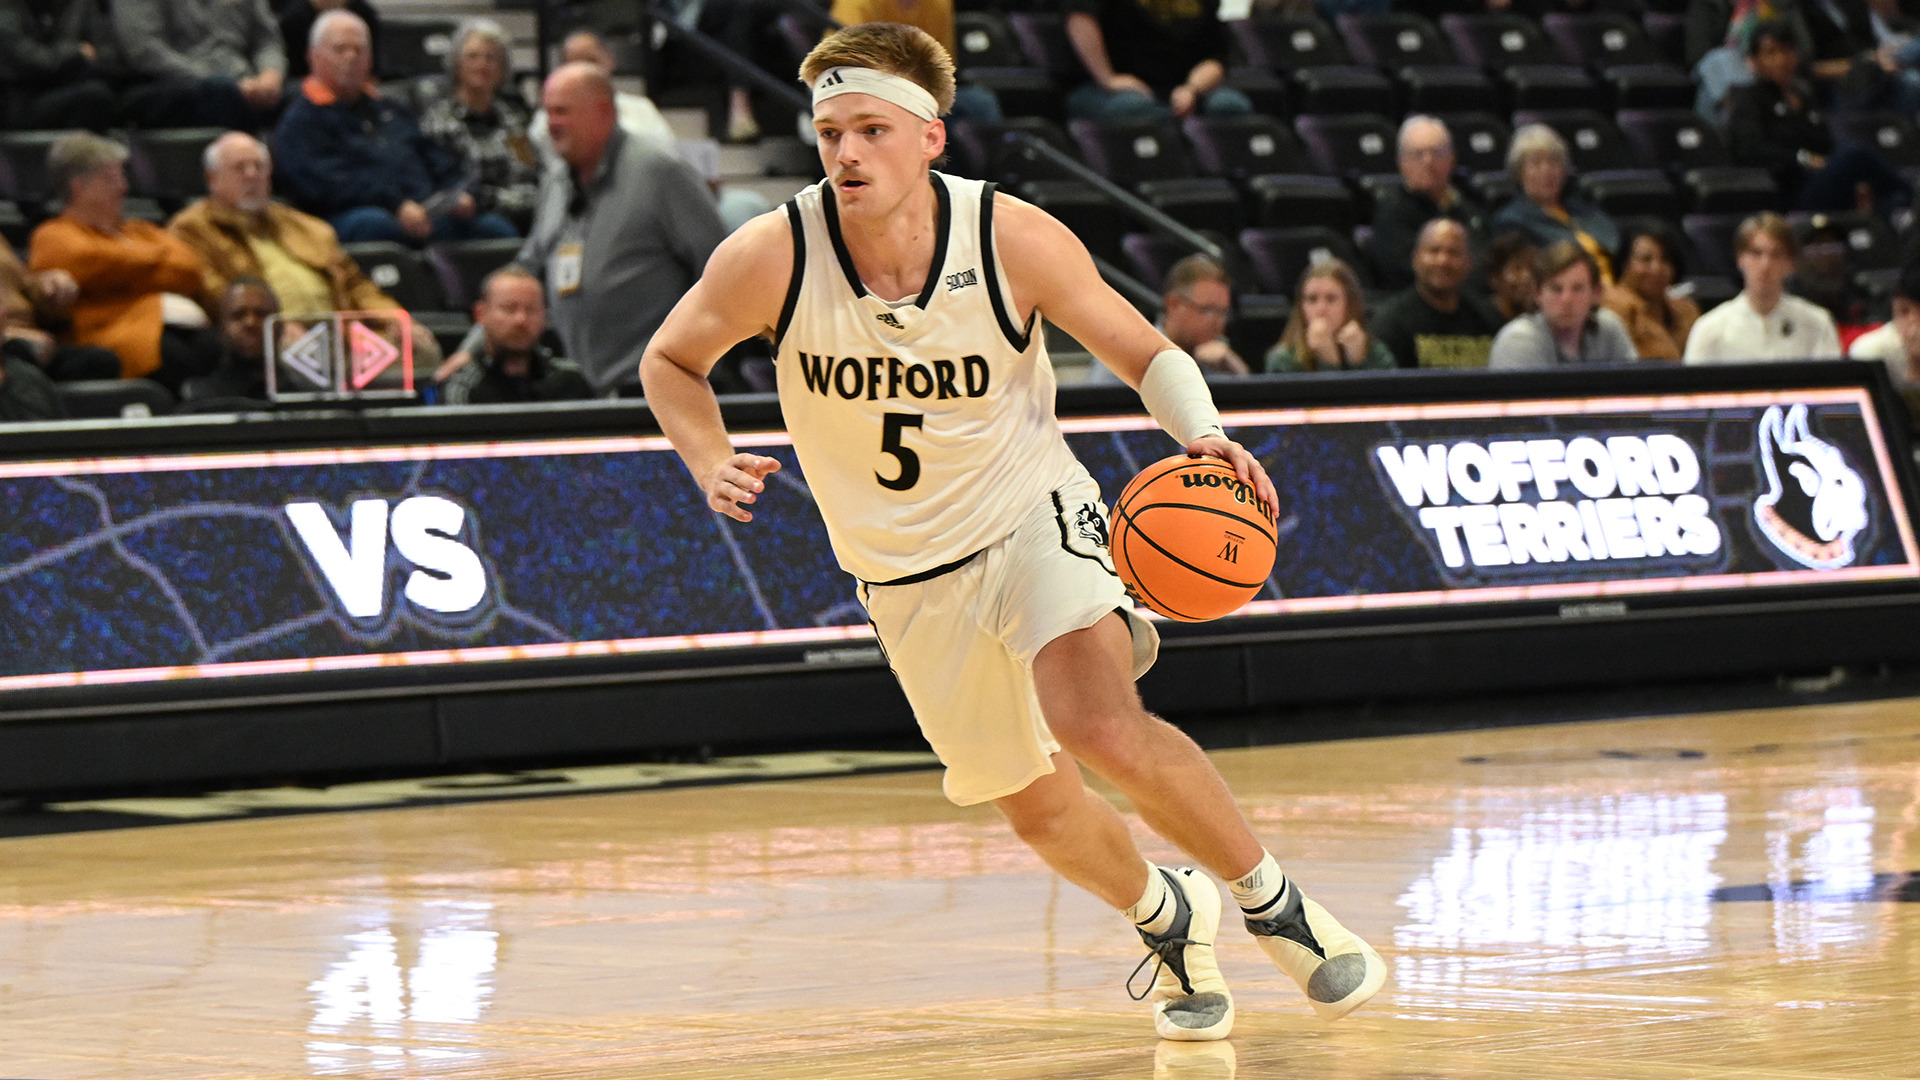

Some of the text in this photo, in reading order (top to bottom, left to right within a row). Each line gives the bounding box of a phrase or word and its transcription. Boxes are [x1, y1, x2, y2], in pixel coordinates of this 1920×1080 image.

[798, 351, 990, 401] WOFFORD
[874, 412, 924, 491] 5
[1377, 435, 1700, 506] WOFFORD
[285, 496, 487, 617] VS
[1217, 541, 1238, 564] W
[1418, 494, 1721, 568] TERRIERS
